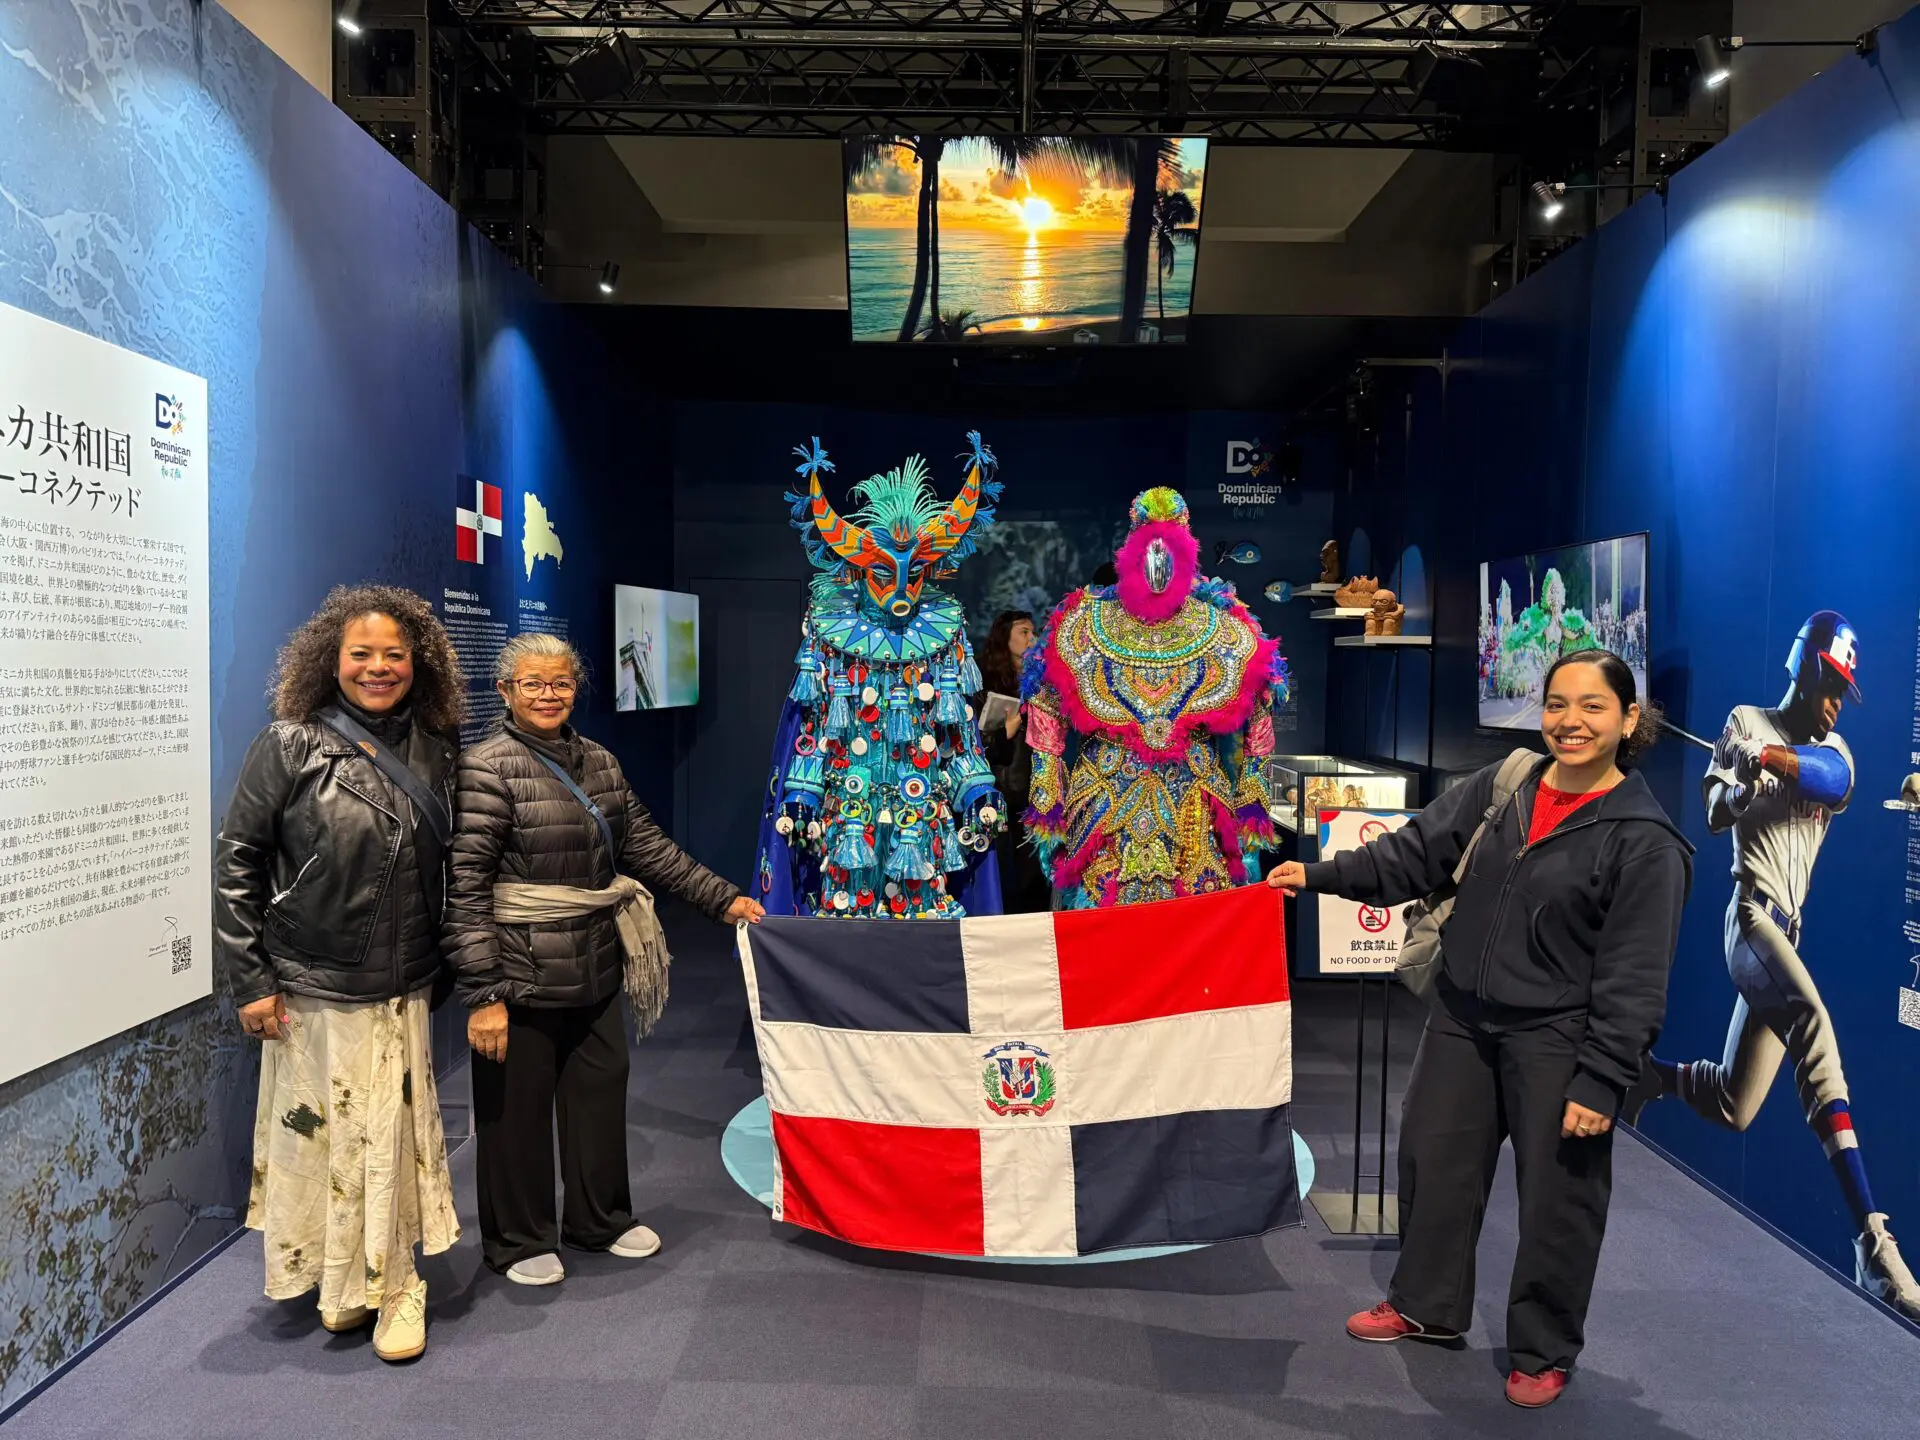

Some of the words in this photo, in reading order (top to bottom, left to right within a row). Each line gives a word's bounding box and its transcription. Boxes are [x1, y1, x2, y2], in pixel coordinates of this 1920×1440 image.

[151, 437, 191, 457] Dominican
[155, 450, 188, 467] Republic
[1218, 483, 1282, 494] Dominican
[1223, 493, 1276, 506] Republic
[444, 587, 470, 601] Bienvenidos
[467, 604, 491, 616] Dominicana
[1350, 940, 1398, 951] 飲食禁止
[1330, 957, 1344, 965] NO
[1346, 956, 1370, 965] FOOD
